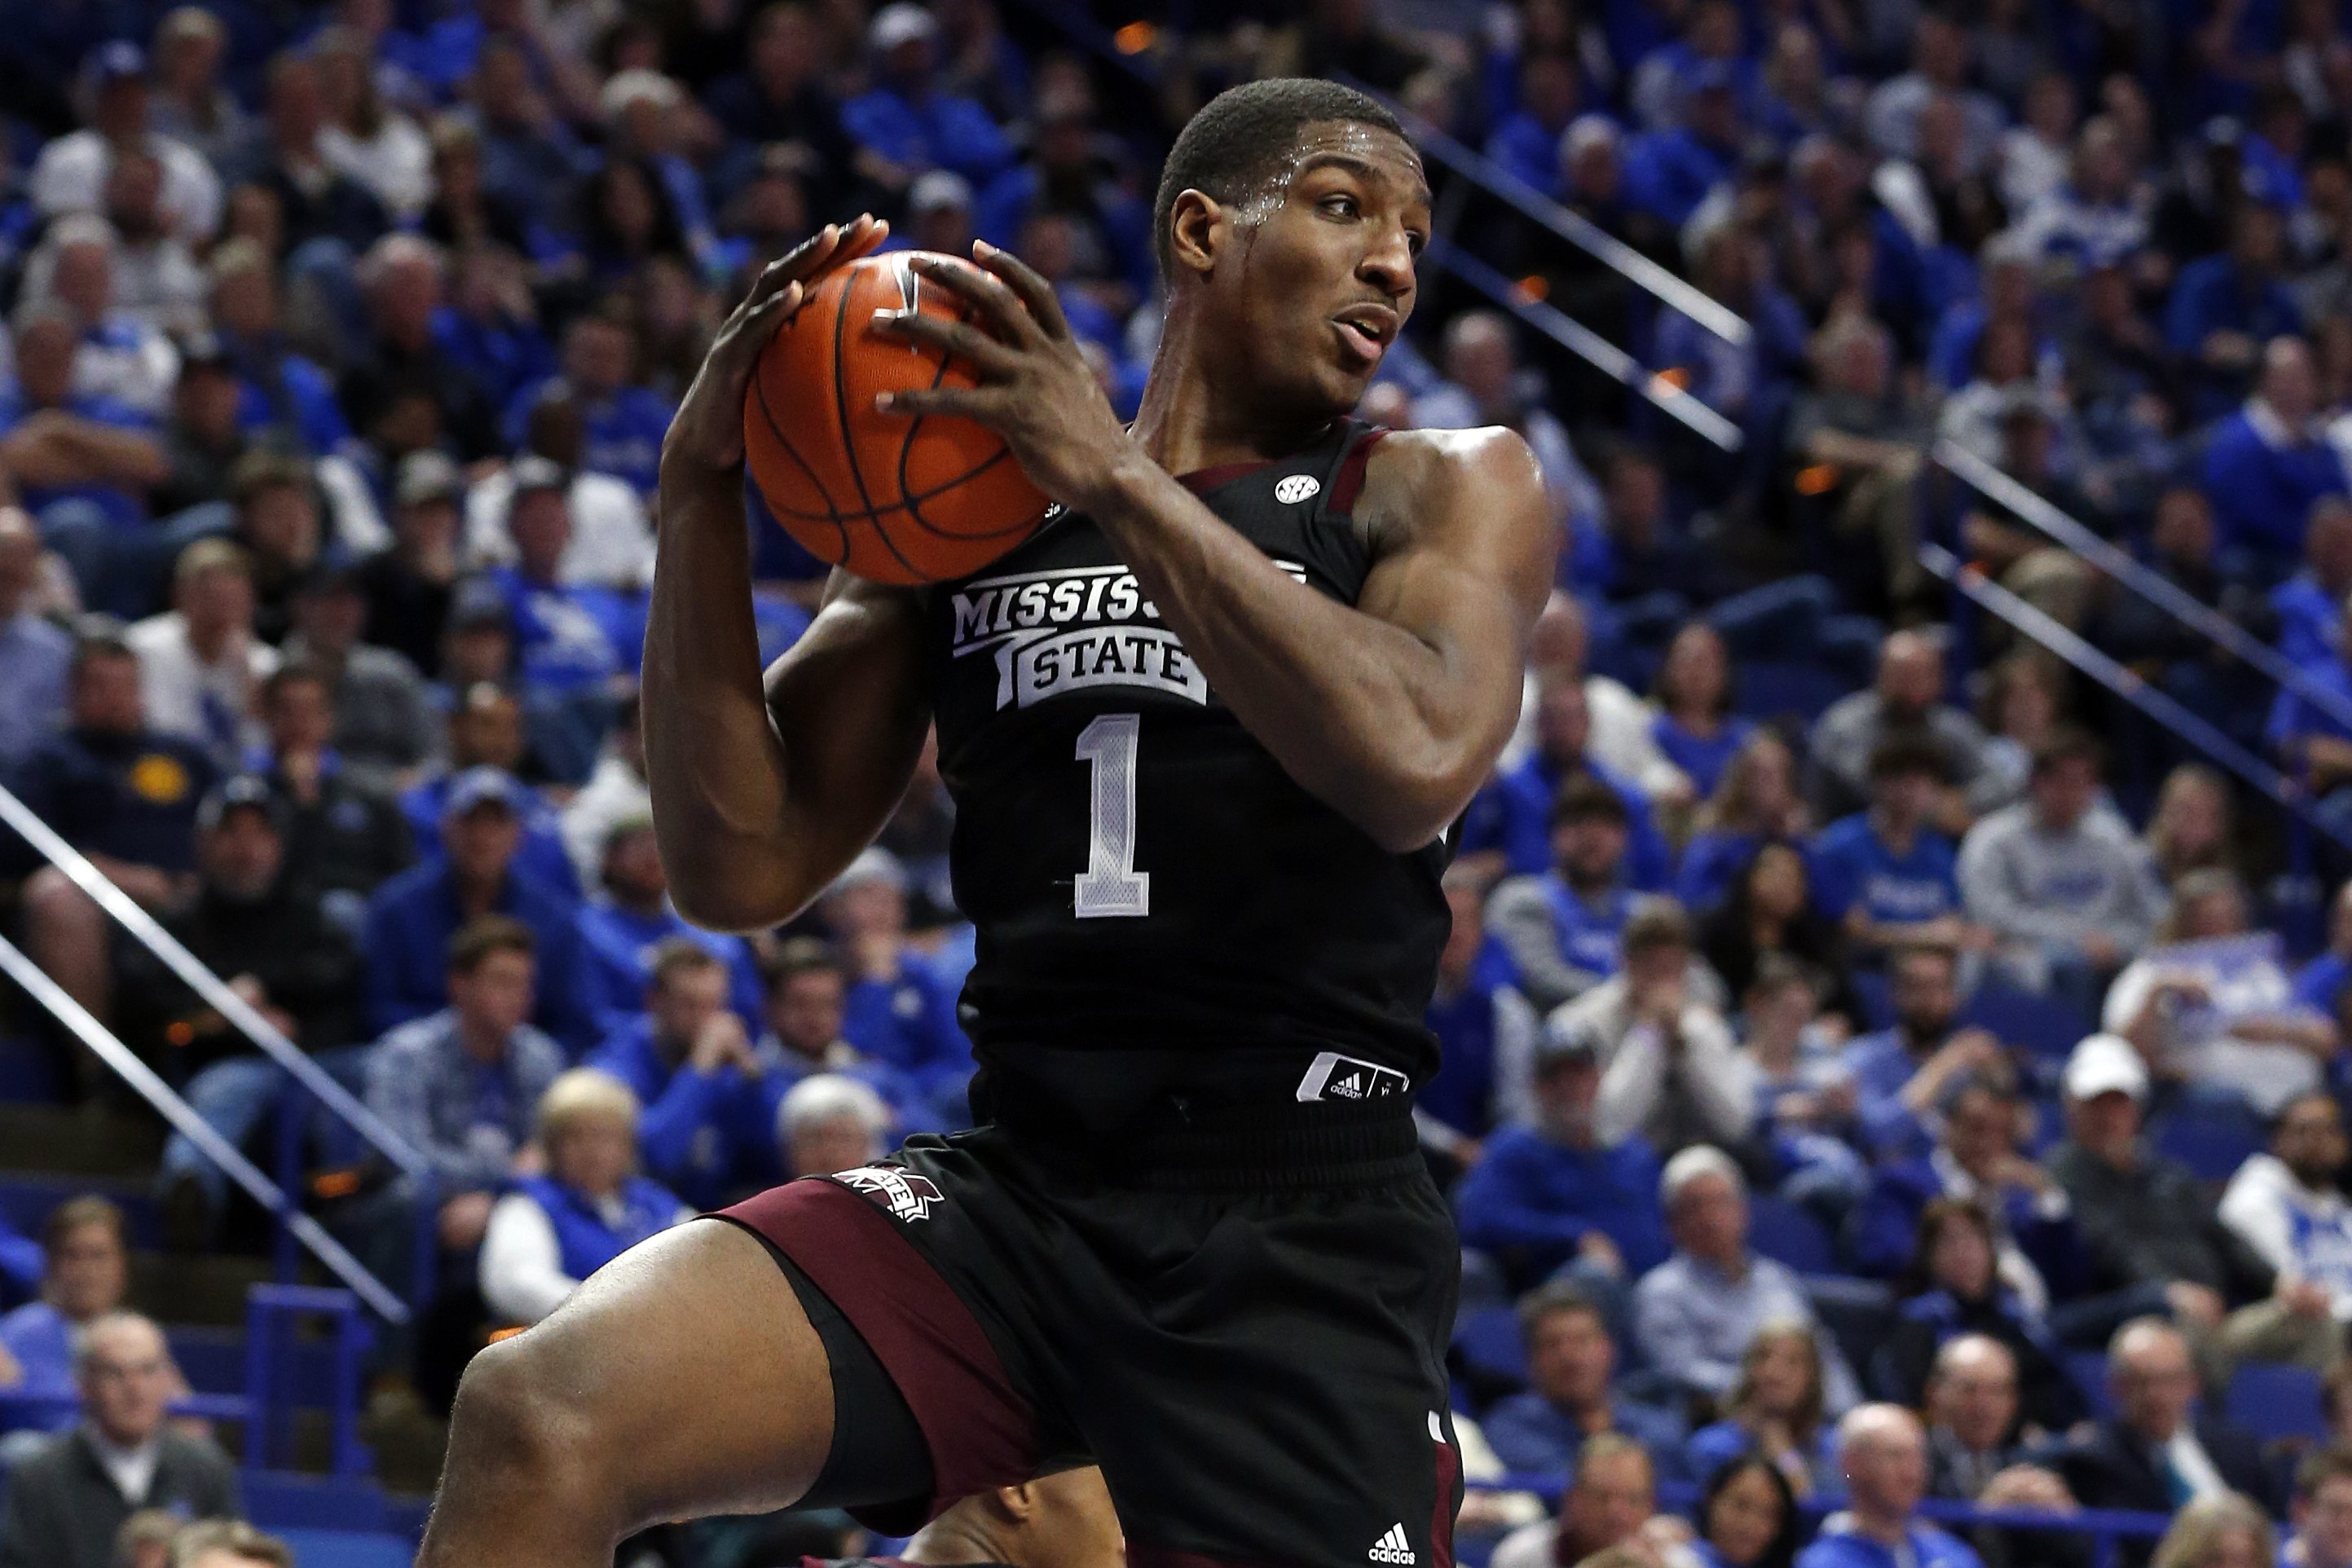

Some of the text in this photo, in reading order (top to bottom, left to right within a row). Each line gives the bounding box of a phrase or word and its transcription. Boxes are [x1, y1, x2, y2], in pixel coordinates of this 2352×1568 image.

[1276, 475, 1319, 503] SEC
[952, 574, 1160, 646] MISSIS
[1034, 635, 1188, 689] STATE
[1075, 713, 1148, 918] 1
[1368, 1547, 1415, 1565] adidas
